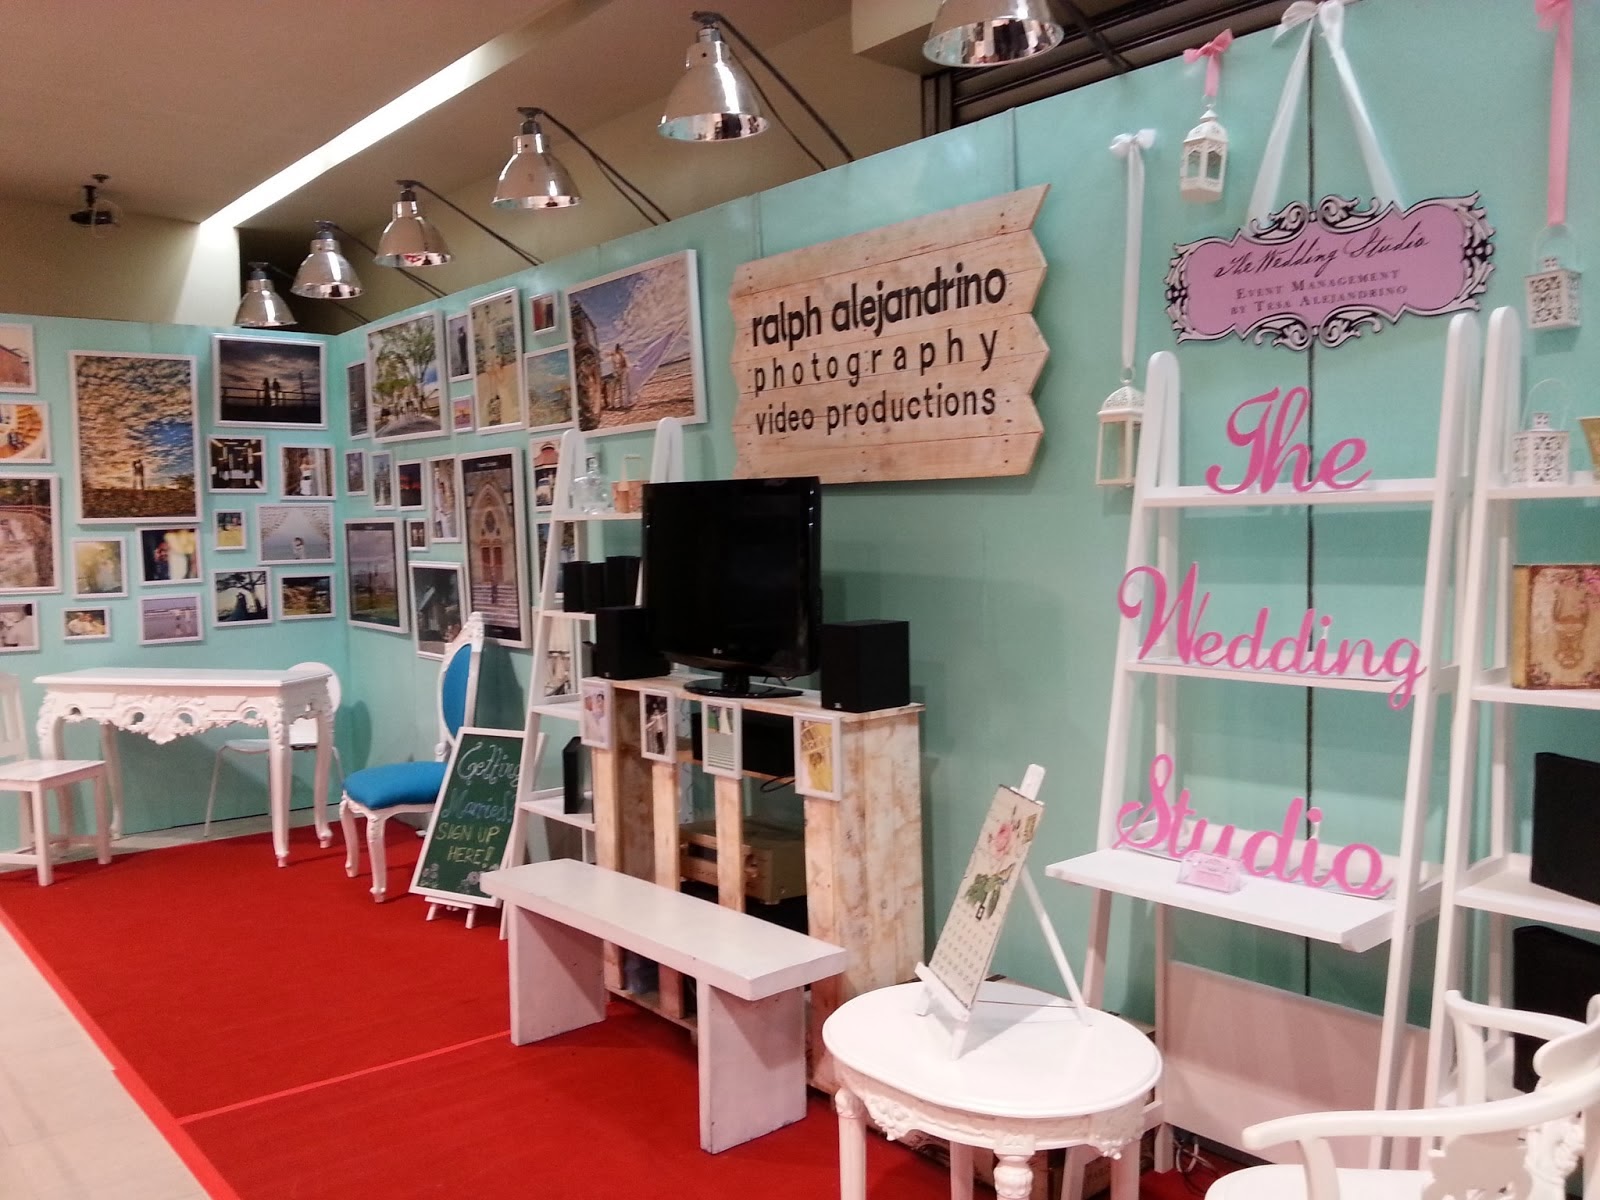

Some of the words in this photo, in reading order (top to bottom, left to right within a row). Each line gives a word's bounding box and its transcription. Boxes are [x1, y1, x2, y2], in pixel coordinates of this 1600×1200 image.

[1214, 252, 1257, 279] The
[1255, 237, 1337, 278] Wedding
[1343, 221, 1430, 258] Studio
[752, 296, 822, 350] ralph
[831, 262, 1006, 337] alejandrino
[754, 328, 998, 398] photography
[756, 403, 814, 435] video
[826, 383, 996, 435] productions
[1205, 386, 1374, 494] The
[1117, 561, 1427, 711] Wedding
[457, 741, 520, 788] Getting
[436, 822, 472, 841] SIGN
[477, 825, 500, 843] UP
[447, 845, 496, 868] HERE!
[1112, 753, 1393, 897] Studio
